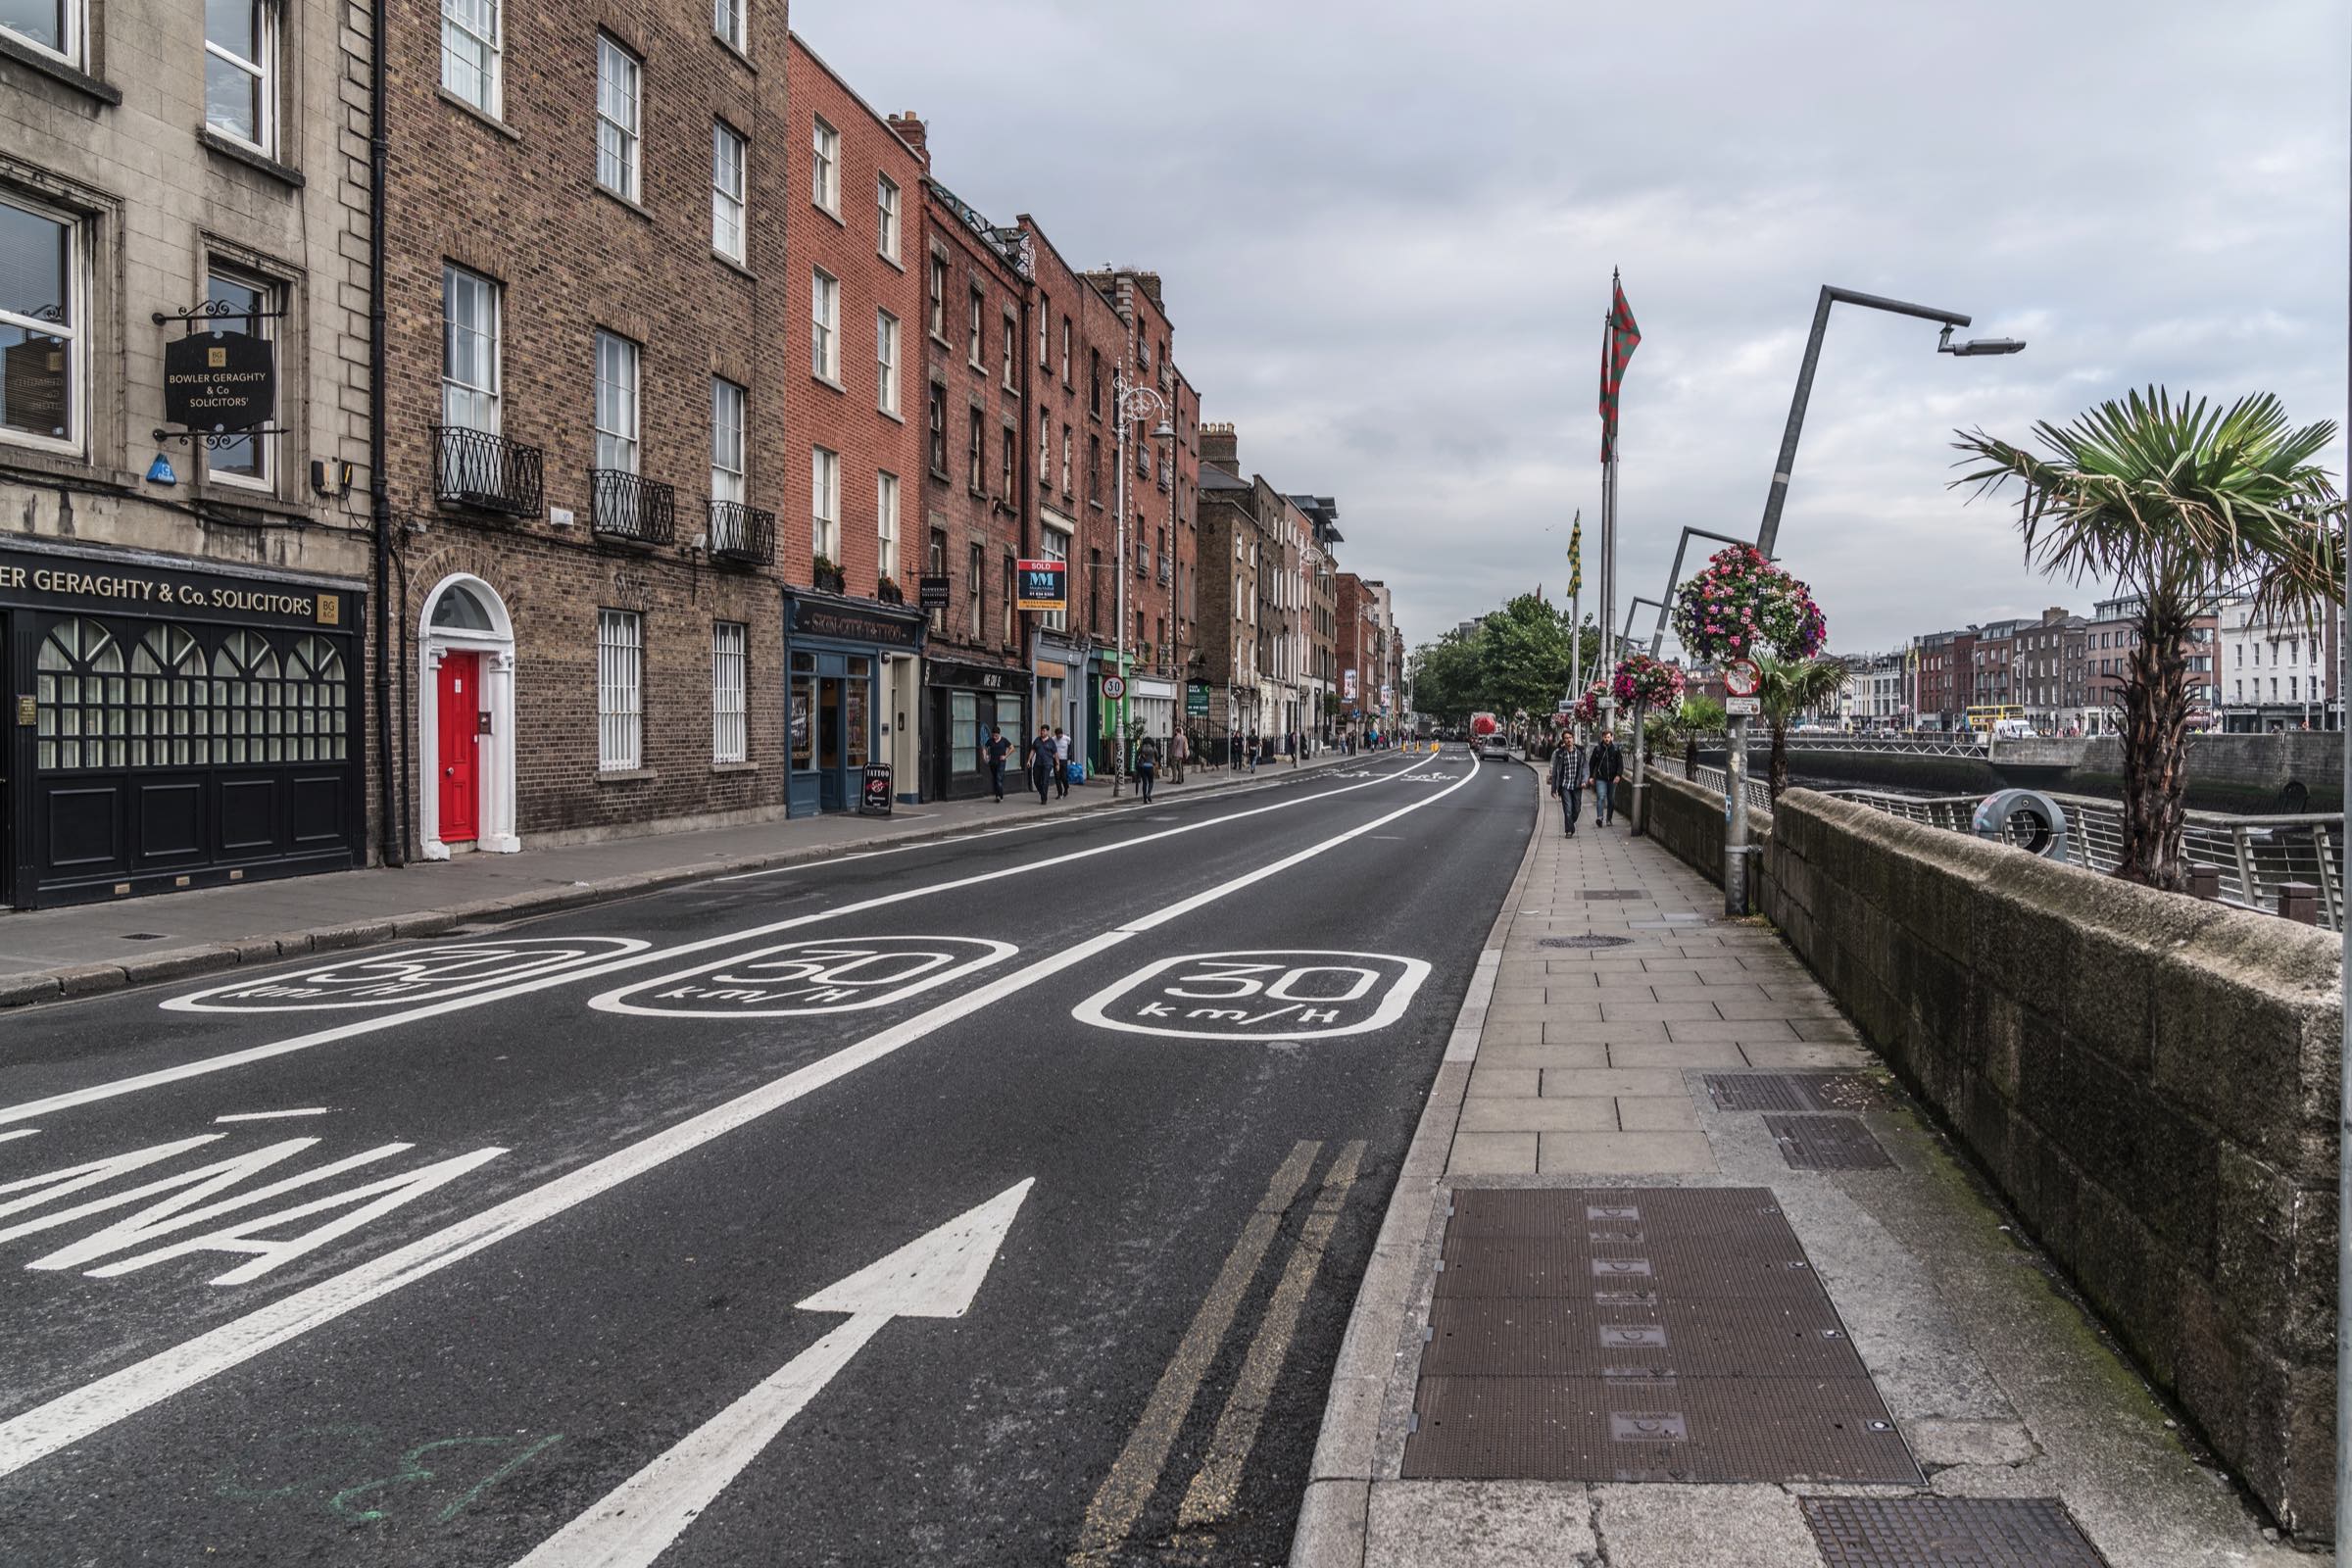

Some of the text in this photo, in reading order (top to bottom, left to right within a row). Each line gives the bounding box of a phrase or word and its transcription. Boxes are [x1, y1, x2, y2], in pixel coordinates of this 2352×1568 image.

[169, 372, 267, 384] BOWLER GERAGHTY
[206, 385, 229, 396] & Co
[33, 568, 154, 601] GERAGHTY
[158, 582, 173, 603] &
[178, 585, 208, 606] Co.
[211, 588, 312, 616] SOLICITORS
[322, 600, 335, 612] BG
[1107, 680, 1120, 692] 30
[307, 949, 587, 983] 30
[711, 951, 956, 986] 30
[1164, 961, 1381, 1002] 30
